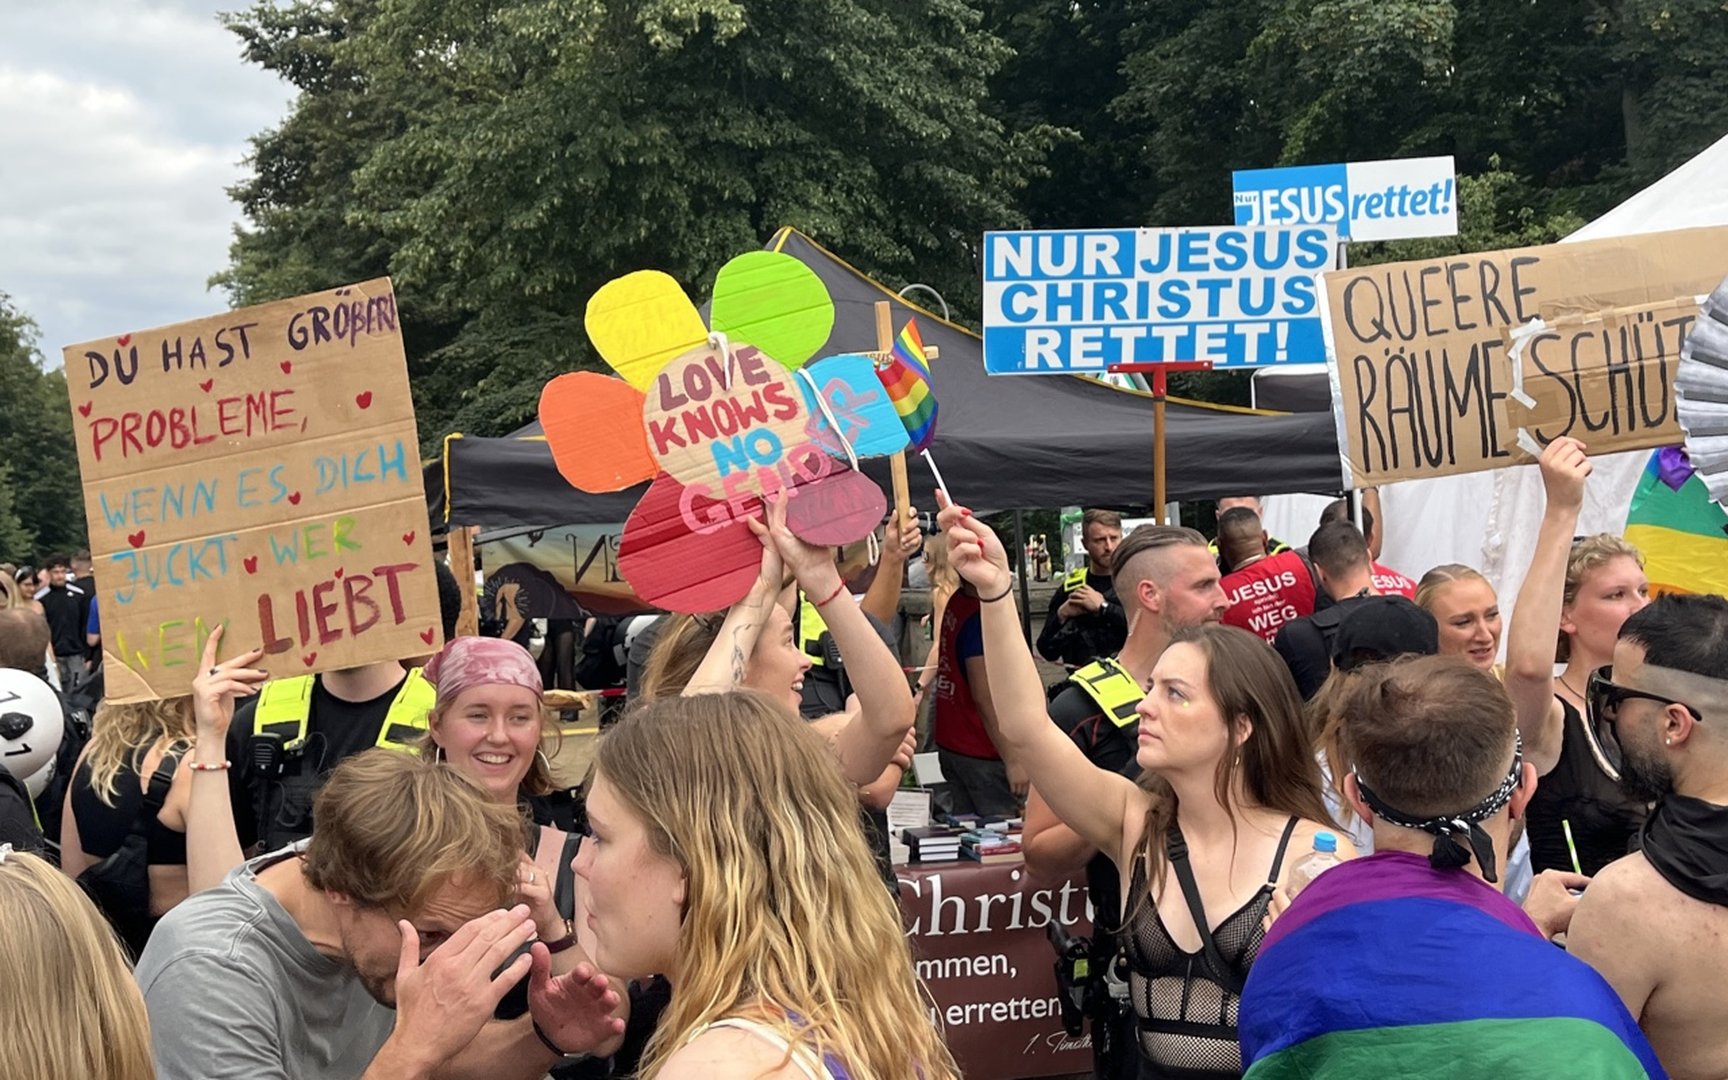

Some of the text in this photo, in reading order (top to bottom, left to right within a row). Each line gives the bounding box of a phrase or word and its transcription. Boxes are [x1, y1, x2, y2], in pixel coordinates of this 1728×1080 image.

[1235, 178, 1453, 226] Nur JESUS rettet!
[992, 228, 1329, 277] NUR JESUS
[1000, 276, 1316, 323] CHRISTUS
[1344, 256, 1541, 344] QUEERE
[84, 344, 139, 389] DU
[162, 322, 259, 373] HAST
[657, 344, 771, 413] LOVE
[1024, 321, 1289, 369] RETTET!
[89, 389, 308, 463] PROBLEME,
[647, 381, 799, 457] KNOWS
[1353, 339, 1511, 474] RÄUME
[100, 440, 408, 533] WENN ES DICH
[710, 427, 784, 479] NO
[111, 516, 363, 606] JUCKT WER
[1229, 571, 1297, 606] JESUS
[257, 562, 419, 656] LIEBT
[1248, 605, 1298, 632] WEG
[945, 997, 1063, 1026] erretten
